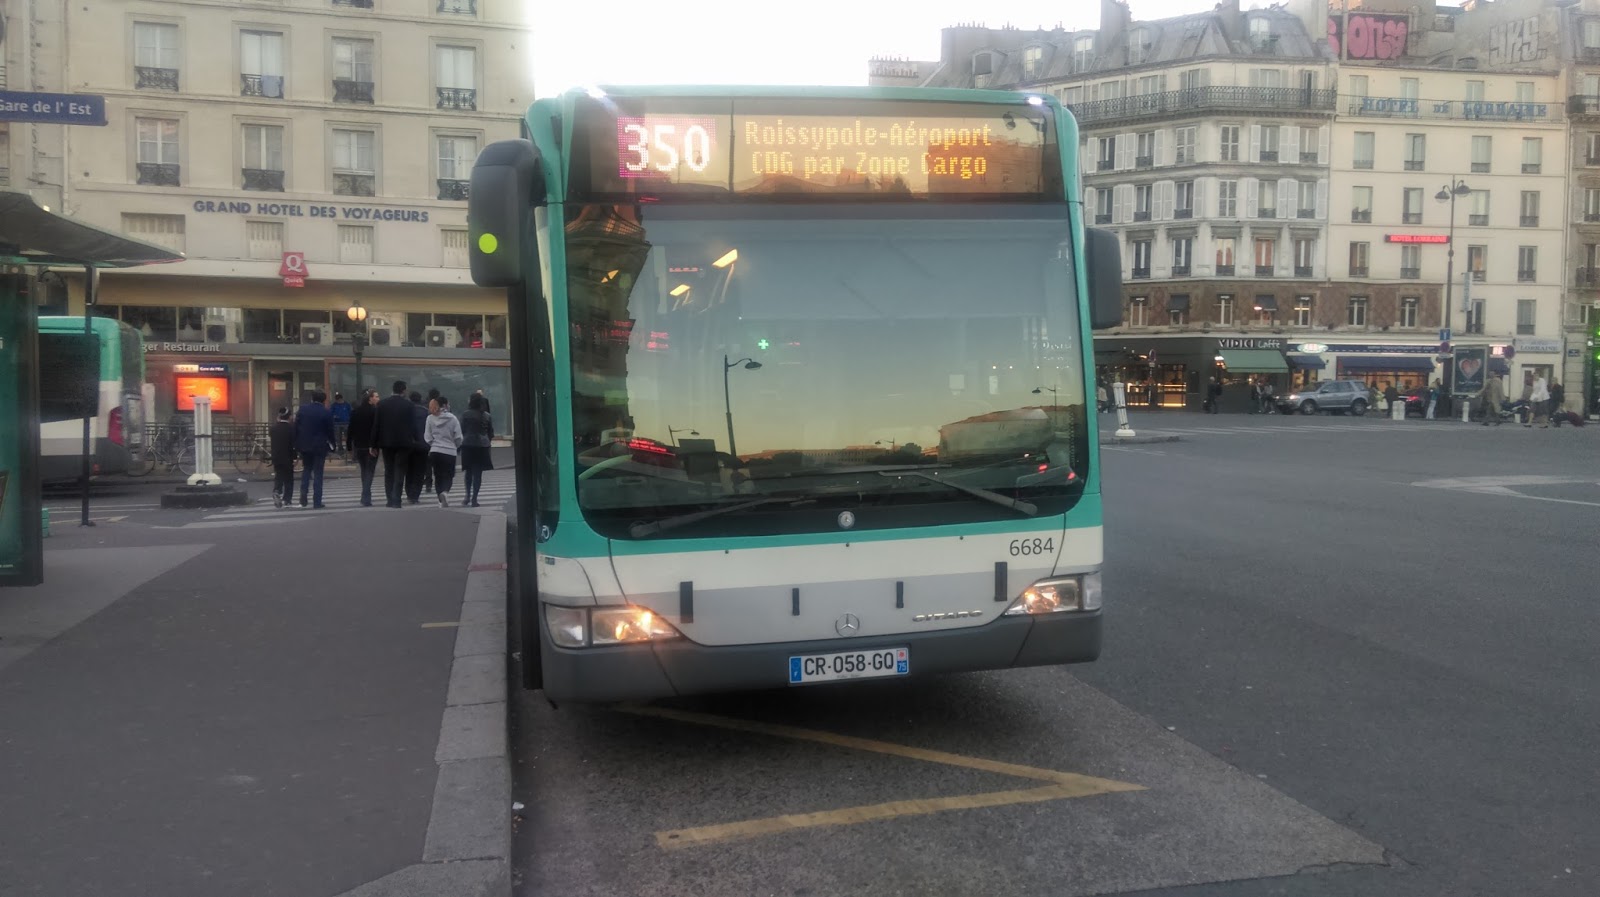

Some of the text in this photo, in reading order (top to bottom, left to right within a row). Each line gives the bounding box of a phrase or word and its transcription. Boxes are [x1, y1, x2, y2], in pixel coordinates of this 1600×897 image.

[32, 101, 51, 113] de
[69, 103, 92, 115] Est
[745, 119, 992, 151] Roissypole-Aéroport
[624, 124, 710, 172] 350
[752, 151, 987, 179] CDG par Zone Cargo
[193, 200, 429, 222] GRAND HOTEL DES VOYAGEURS
[286, 254, 303, 273] Q
[163, 341, 220, 352] Restaurant
[1009, 537, 1054, 556] 6684
